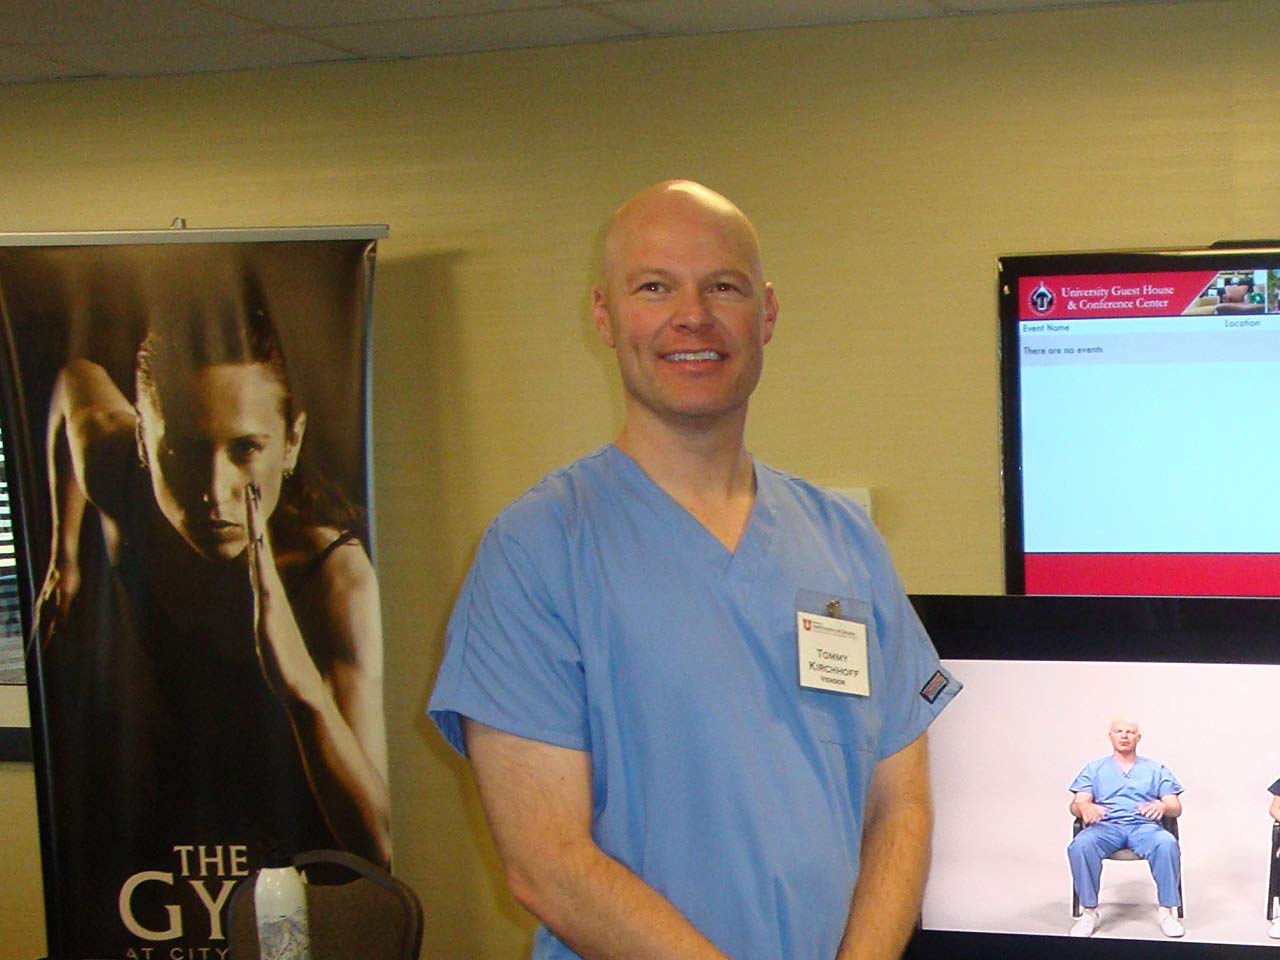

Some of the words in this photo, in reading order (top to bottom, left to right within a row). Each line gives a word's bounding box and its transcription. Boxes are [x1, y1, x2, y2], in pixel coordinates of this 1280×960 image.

[1061, 287, 1109, 302] University
[1111, 285, 1140, 296] Guest
[1143, 284, 1174, 295] House
[1067, 301, 1077, 310] &
[1079, 299, 1134, 310] Conference
[1136, 298, 1169, 308] Center
[1022, 324, 1044, 333] Event
[1046, 323, 1070, 332] Name
[1224, 319, 1261, 329] Location
[1023, 346, 1046, 355] There
[1077, 346, 1103, 354] events
[173, 844, 249, 877] THE
[118, 870, 238, 942] GY
[126, 947, 155, 960] AT
[169, 947, 230, 960] CITY
